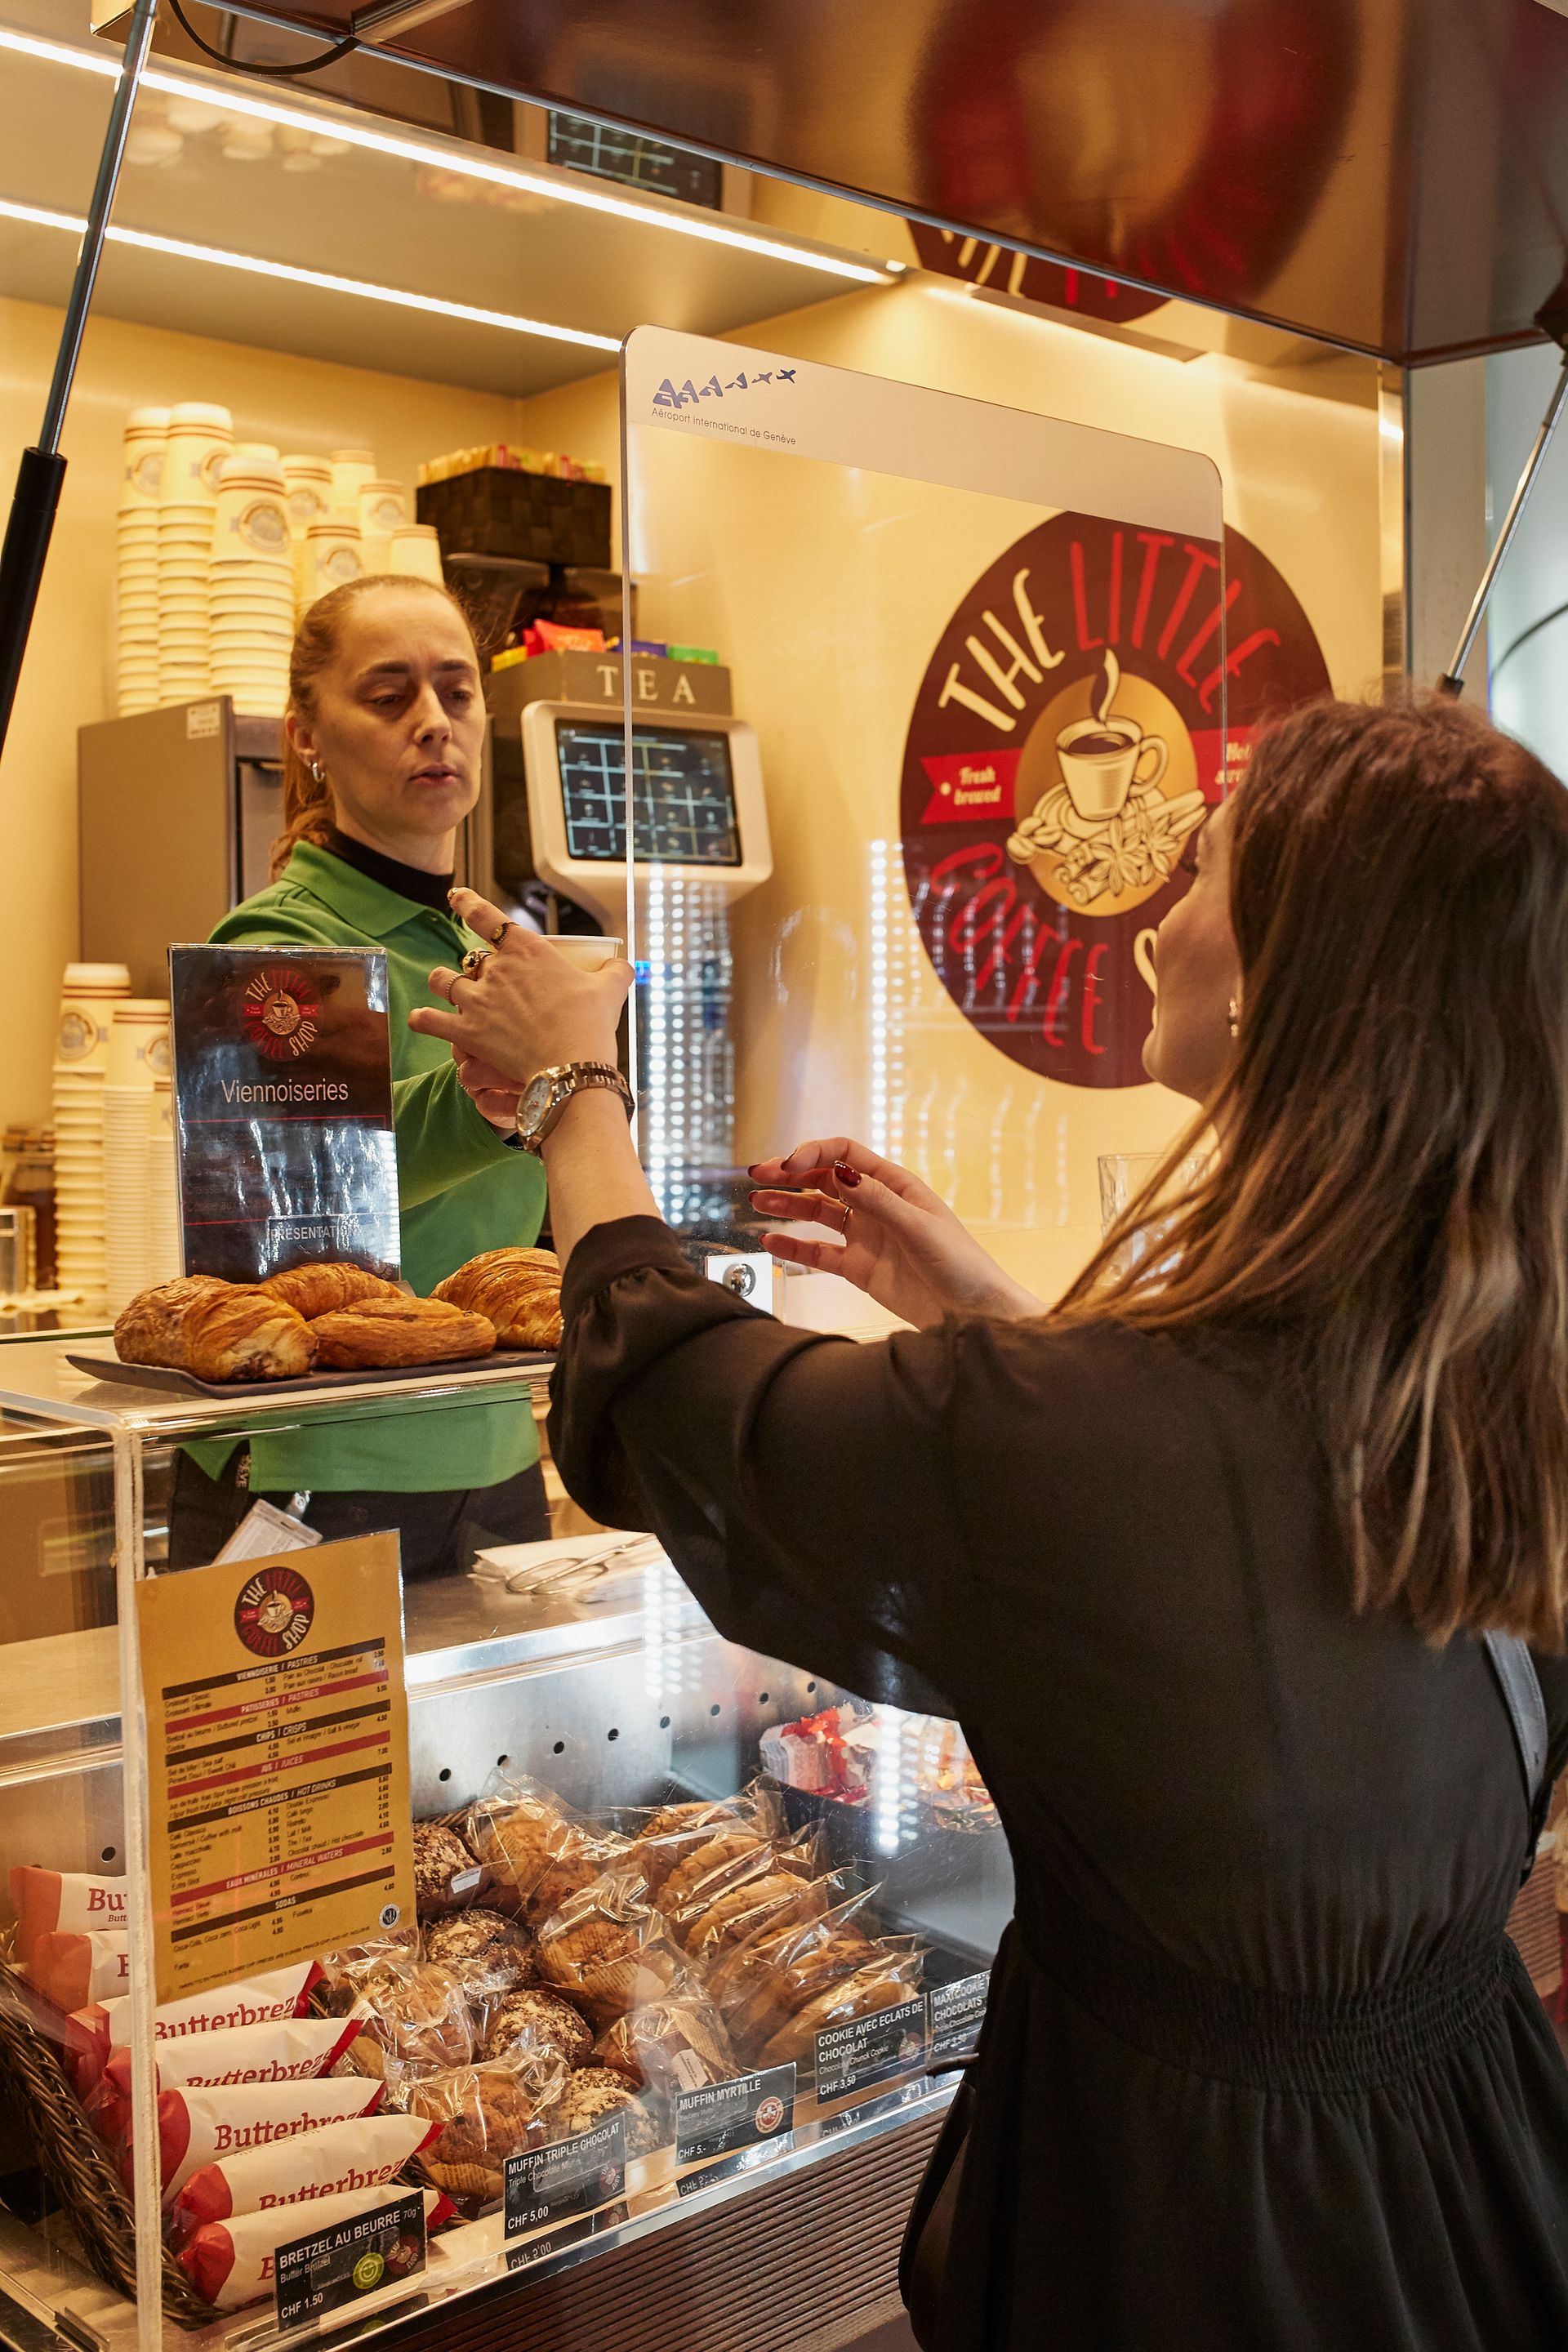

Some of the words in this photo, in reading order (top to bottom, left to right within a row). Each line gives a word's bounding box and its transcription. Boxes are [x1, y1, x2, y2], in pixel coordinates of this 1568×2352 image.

[652, 408, 691, 424] Aéroport
[693, 416, 747, 435] International
[750, 428, 761, 438] de
[763, 430, 796, 445] Genève
[938, 568, 1066, 732] THE
[1069, 531, 1281, 715] LITTLE
[596, 665, 697, 705] TEA
[929, 843, 1109, 1057] COFFEE
[245, 972, 273, 1001] THE
[288, 1021, 318, 1057] SHOP
[220, 1078, 349, 1103] Viennoiseries
[241, 1577, 267, 1606] THE
[282, 1614, 310, 1650] SHOP
[287, 1655, 318, 1669] PASTRIES
[287, 1687, 320, 1702] PASTRIES
[283, 1722, 307, 1737] CRISPS
[280, 1755, 304, 1768] JUICES
[296, 1784, 311, 1797] HOT
[311, 1779, 337, 1793] DRINKS
[287, 1856, 317, 1872] MINERAL
[317, 1848, 344, 1863] WATERS
[275, 1896, 296, 1909] SODAS
[934, 1996, 983, 2022] CHOCOLATS
[818, 2027, 854, 2047] COOKIE
[855, 2018, 878, 2036] AVEC
[879, 2007, 911, 2027] ECLATS
[911, 2001, 924, 2014] DE
[818, 2038, 868, 2063] CHOCOLAT
[871, 2044, 889, 2058] Cookie
[679, 2091, 715, 2110] MUFFIN
[716, 2079, 761, 2101] MYRTILLE
[819, 2080, 840, 2096] CHF
[508, 2154, 544, 2176] MUFFIN
[546, 2141, 579, 2163] TRIPLE
[580, 2122, 620, 2151] CHOCOLAT
[678, 2145, 695, 2159] CHF
[508, 2176, 527, 2189] Triple
[528, 2164, 560, 2183] Chocolate
[507, 2211, 528, 2230] CHF
[529, 2205, 550, 2224] 5,00
[279, 2238, 335, 2270] BRETZEL
[335, 2230, 352, 2247] AU
[354, 2209, 402, 2240] BEURRE
[403, 2208, 417, 2220] 70g
[280, 2267, 303, 2284] Butter
[281, 2298, 302, 2319] CHF
[303, 2292, 324, 2310] 1.50
